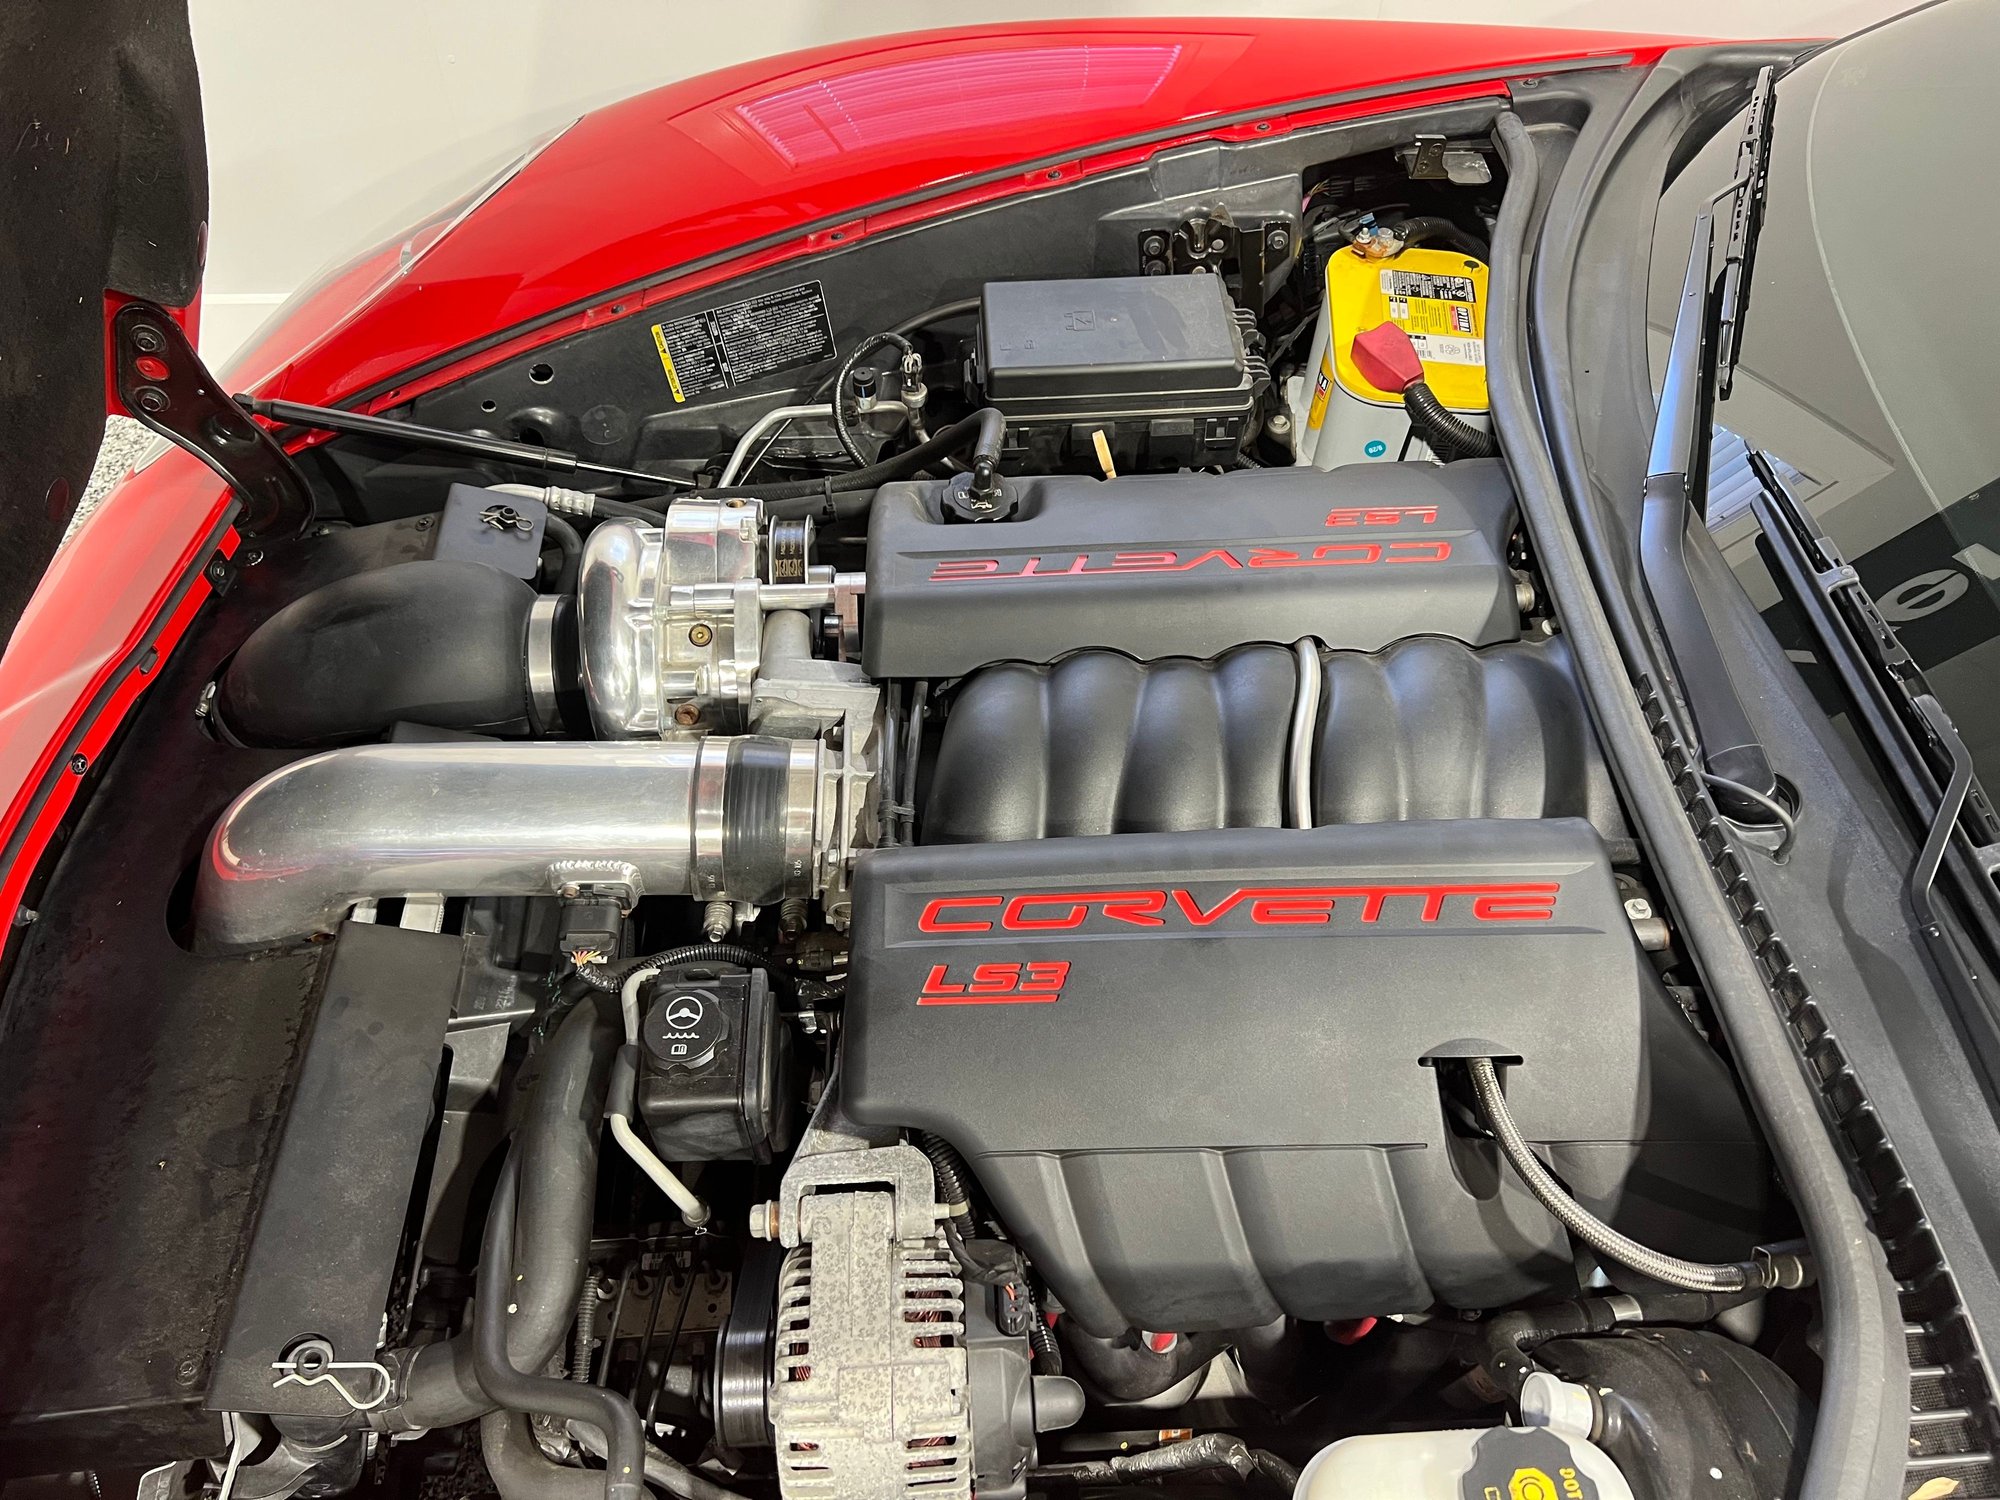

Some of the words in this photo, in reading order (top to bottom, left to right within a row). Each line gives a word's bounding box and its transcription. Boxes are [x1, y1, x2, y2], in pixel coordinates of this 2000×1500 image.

[1457, 306, 1470, 331] OPTIMA
[1325, 505, 1439, 527] LS3
[930, 541, 1453, 581] CORVETTE
[918, 882, 1561, 934] CORVETTE
[921, 961, 1071, 994] LS3
